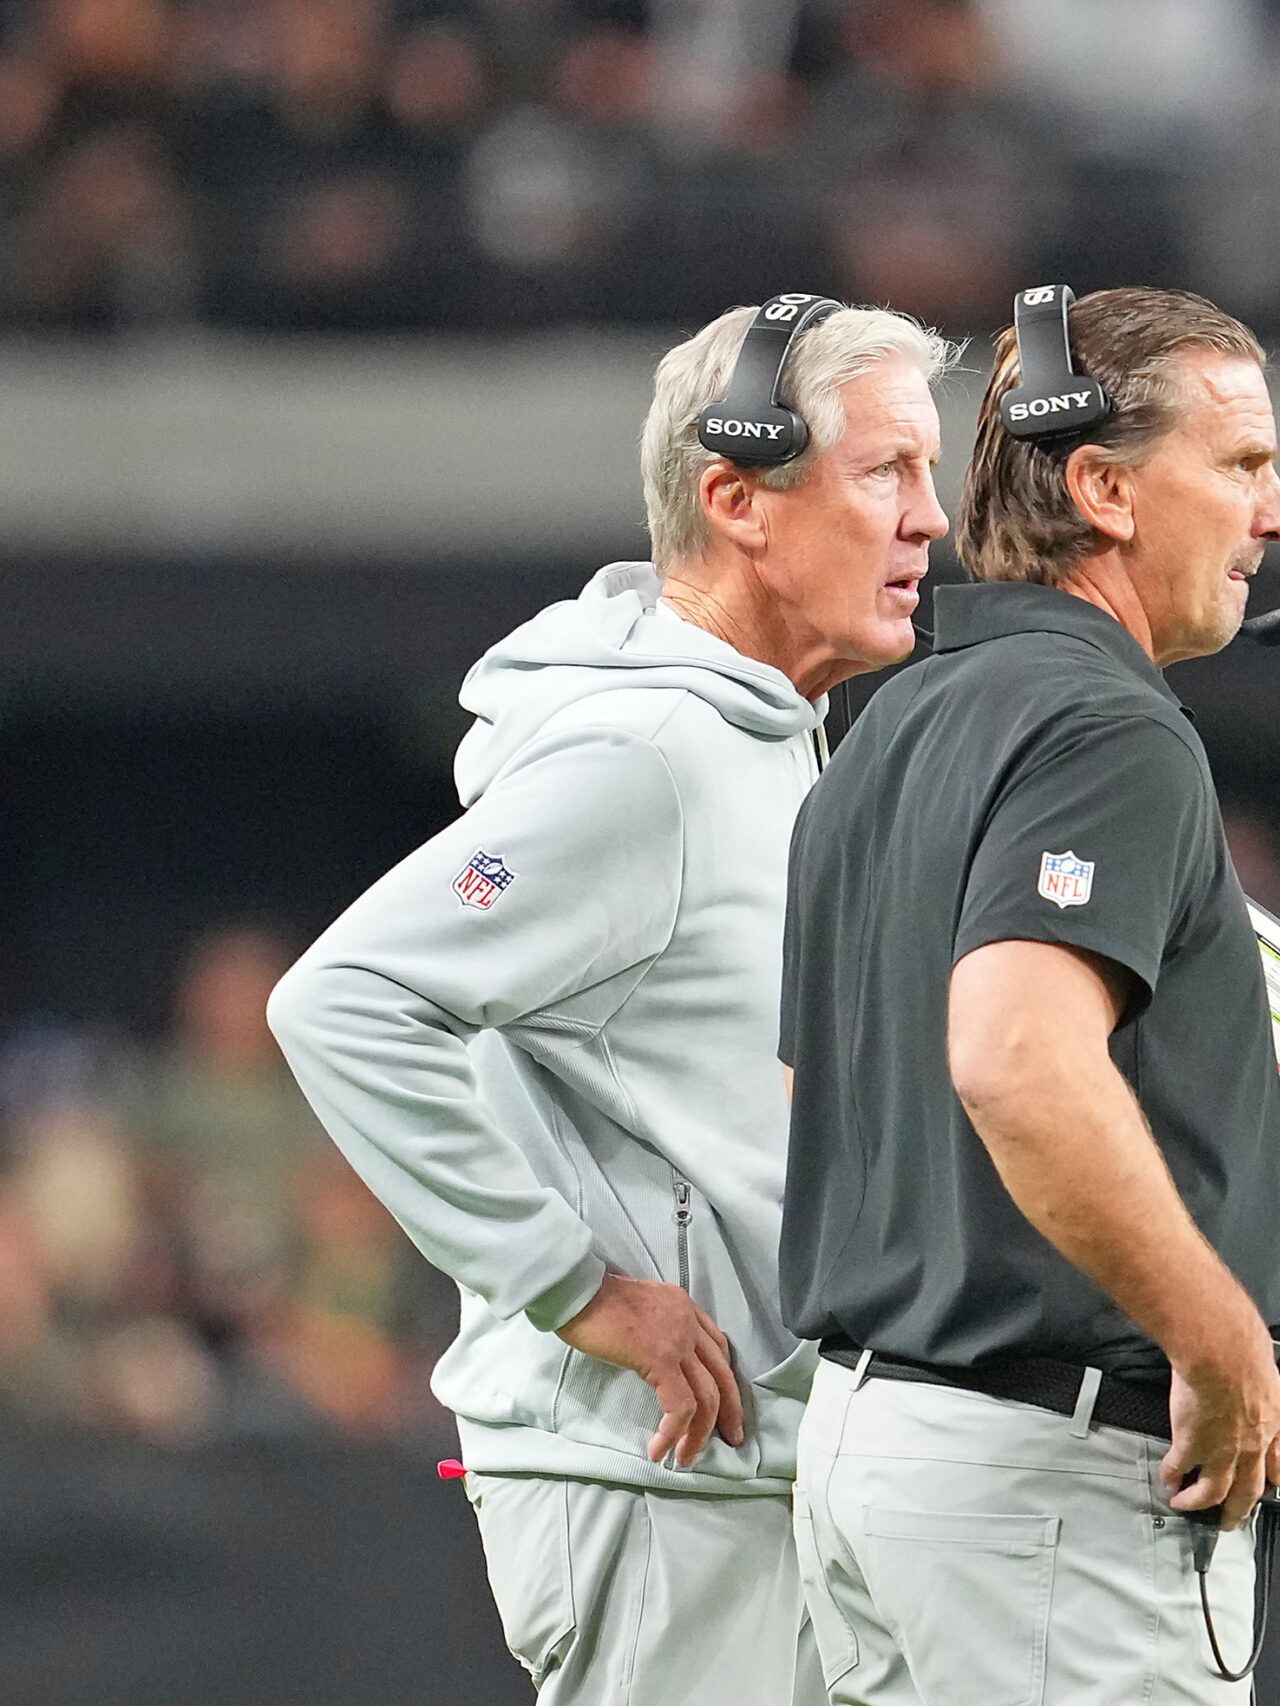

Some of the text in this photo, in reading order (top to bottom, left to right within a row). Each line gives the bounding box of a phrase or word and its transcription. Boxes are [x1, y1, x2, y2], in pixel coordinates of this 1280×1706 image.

[1009, 391, 1092, 422] SONY
[706, 418, 785, 440] SONY
[457, 867, 496, 907] NFL
[1046, 873, 1084, 897] NFL
